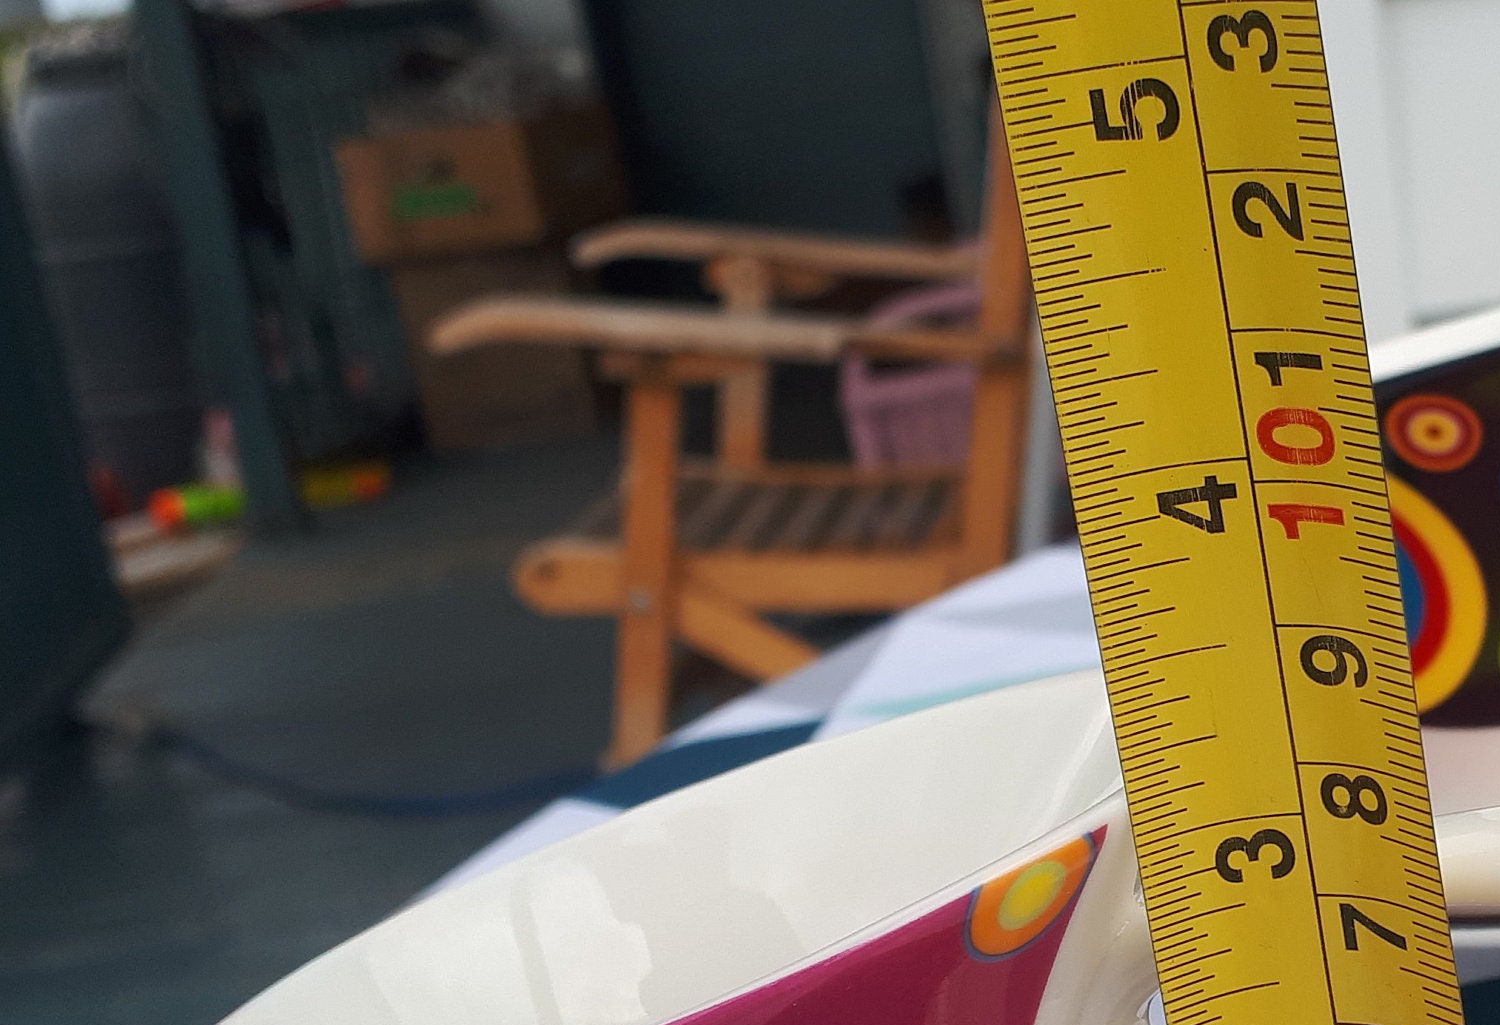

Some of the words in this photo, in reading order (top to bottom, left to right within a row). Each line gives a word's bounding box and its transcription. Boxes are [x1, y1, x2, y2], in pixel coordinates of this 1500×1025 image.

[1207, 9, 1278, 73] 3
[1089, 77, 1181, 142] 5
[1232, 180, 1305, 242] 2
[1156, 474, 1237, 534] 4
[1299, 634, 1368, 688] 9
[1320, 772, 1388, 826] 8
[1215, 828, 1296, 884] 3
[1340, 903, 1407, 951] 7
